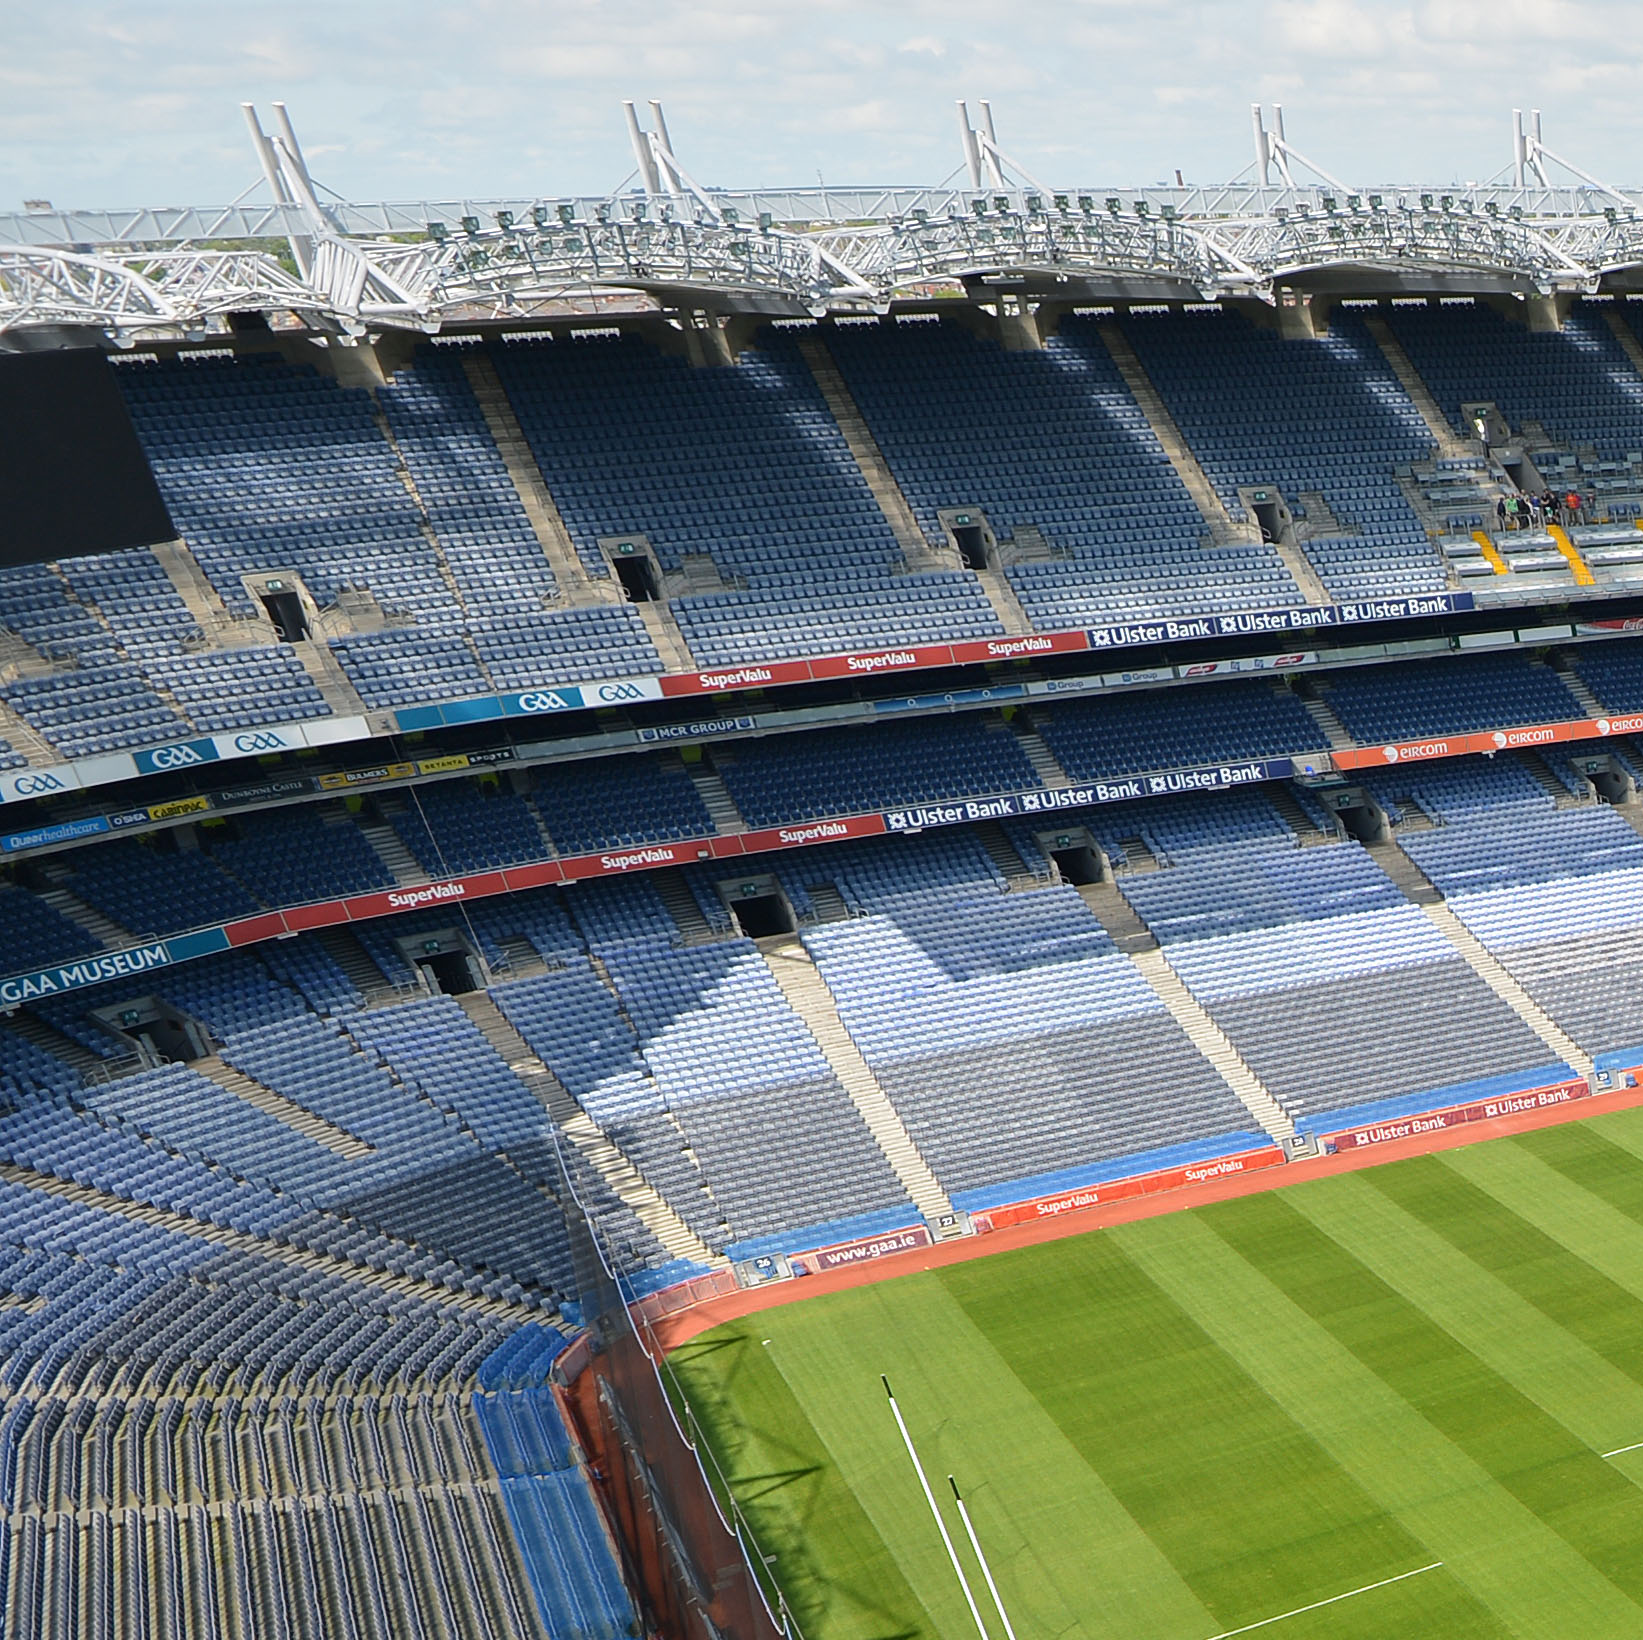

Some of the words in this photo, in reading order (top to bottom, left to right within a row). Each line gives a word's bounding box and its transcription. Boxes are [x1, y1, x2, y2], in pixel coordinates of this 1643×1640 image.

[1238, 611, 1289, 632] Ulster
[1292, 608, 1332, 627] Bank
[1358, 602, 1406, 621] Ulster
[1409, 596, 1448, 614] Bank
[1111, 622, 1167, 645] Ulster
[1168, 618, 1211, 639] Bank
[987, 638, 1052, 656] SuperValu
[847, 652, 916, 671] SuperValu
[700, 669, 772, 689] SuperValu
[519, 687, 568, 712] GAA
[599, 683, 645, 702] GAA
[659, 726, 687, 739] MCR
[690, 720, 734, 735] GROUP
[234, 731, 287, 752] GAA
[152, 746, 202, 769] GAA
[424, 759, 464, 770] SETANTA
[14, 773, 65, 796] GAA
[1167, 770, 1218, 791] Ulster
[1220, 764, 1262, 784] Bank
[1043, 786, 1095, 808] Ulster
[1098, 780, 1141, 800] Bank
[908, 804, 967, 827] Ulster
[970, 798, 1014, 819] Bank
[779, 822, 847, 843] SuperValu
[601, 849, 674, 870] SuperValu
[388, 883, 464, 908] SuperValu
[1, 971, 57, 1001] GAA
[60, 945, 169, 988] MUSEUM
[1498, 1095, 1536, 1114] Ulster
[1538, 1088, 1570, 1106] Bank
[1369, 1123, 1410, 1143] Ulster
[1412, 1115, 1446, 1134] Bank
[1185, 1160, 1243, 1182] SuperValu
[1037, 1193, 1098, 1215] SuperValu
[941, 1217, 953, 1227] 27
[826, 1234, 916, 1264] www.gaa.ie
[756, 1258, 770, 1268] 26
